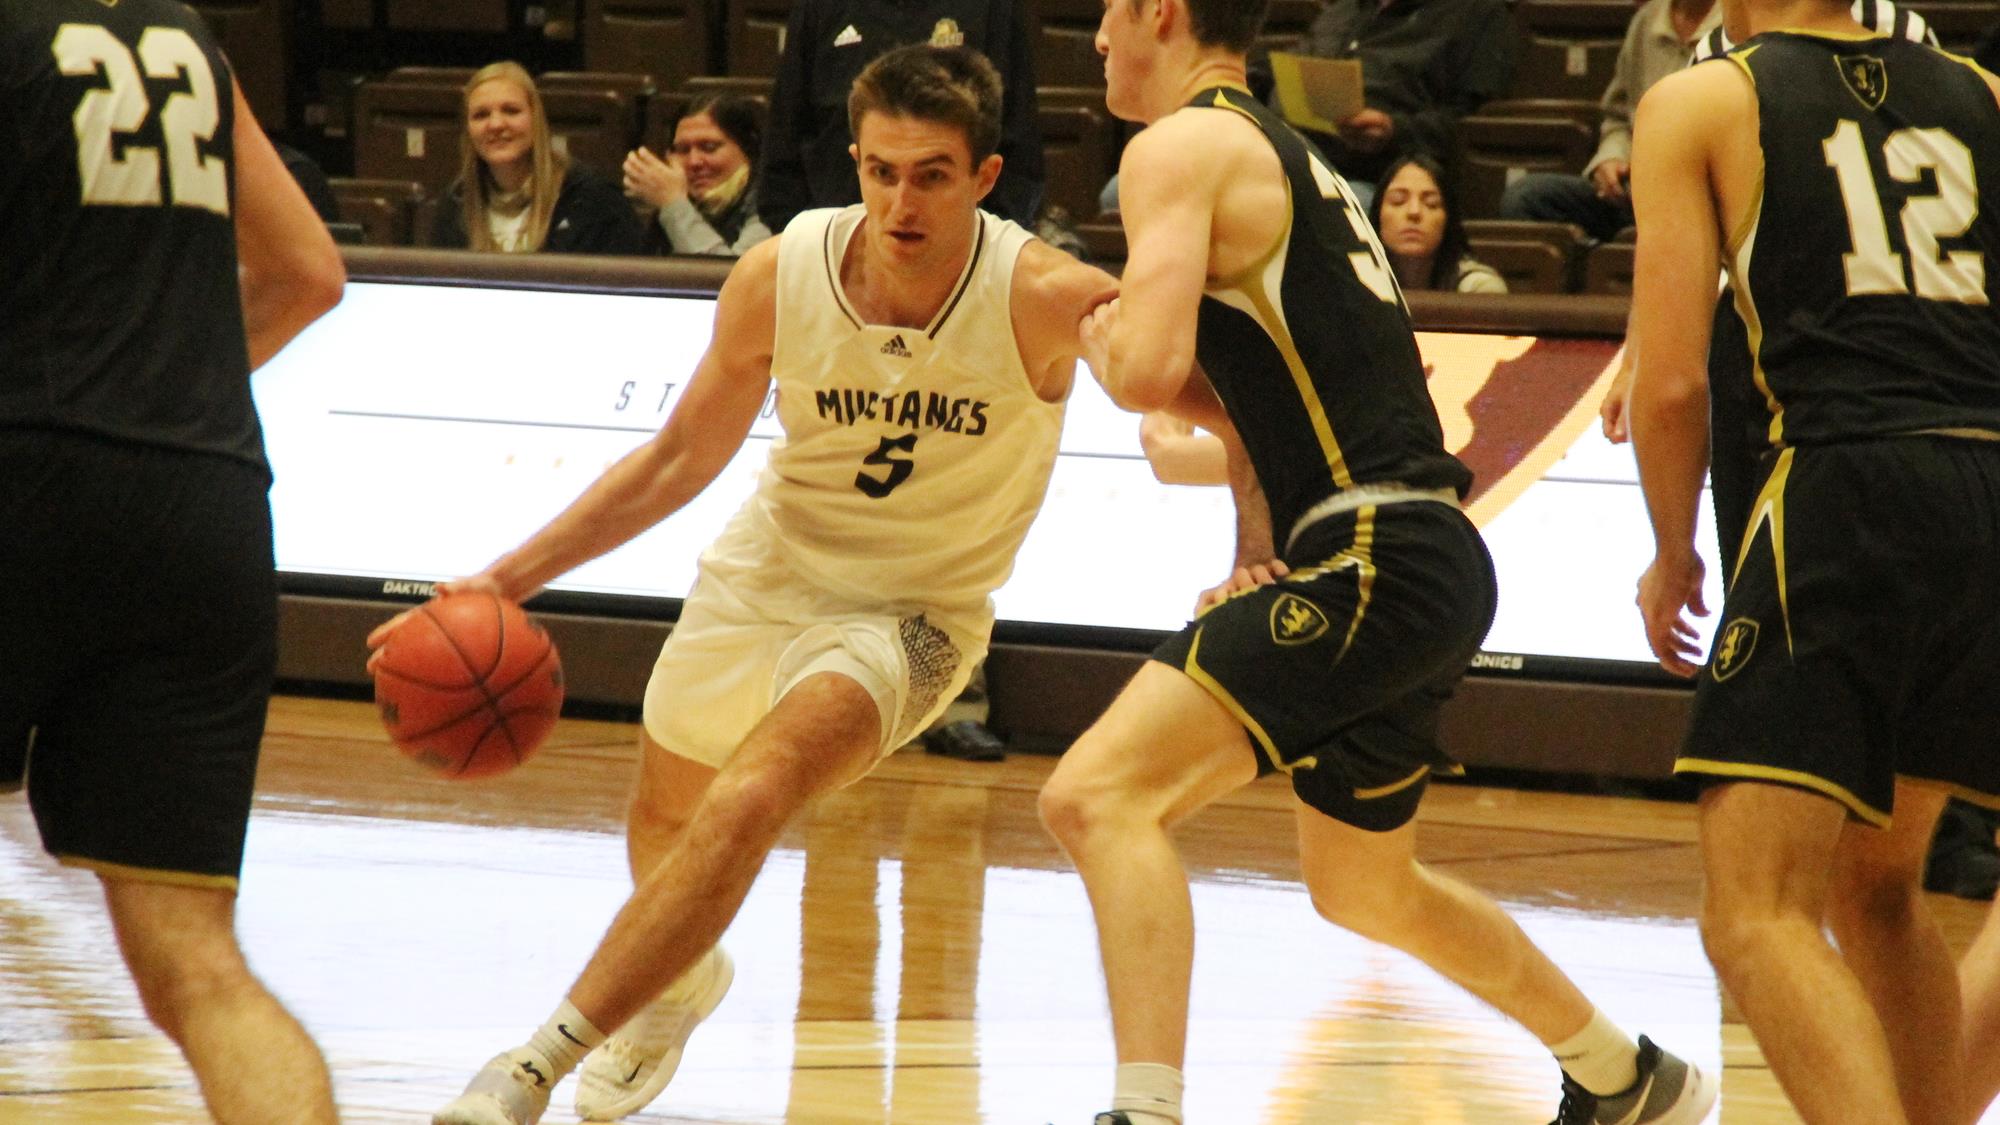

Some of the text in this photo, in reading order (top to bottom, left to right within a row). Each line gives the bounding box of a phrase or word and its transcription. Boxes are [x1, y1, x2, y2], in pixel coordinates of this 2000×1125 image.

[51, 23, 230, 218] 22
[1307, 150, 1411, 318] 3
[1822, 118, 1990, 306] 12
[815, 388, 990, 436] MUSTANGS
[854, 433, 918, 498] 5
